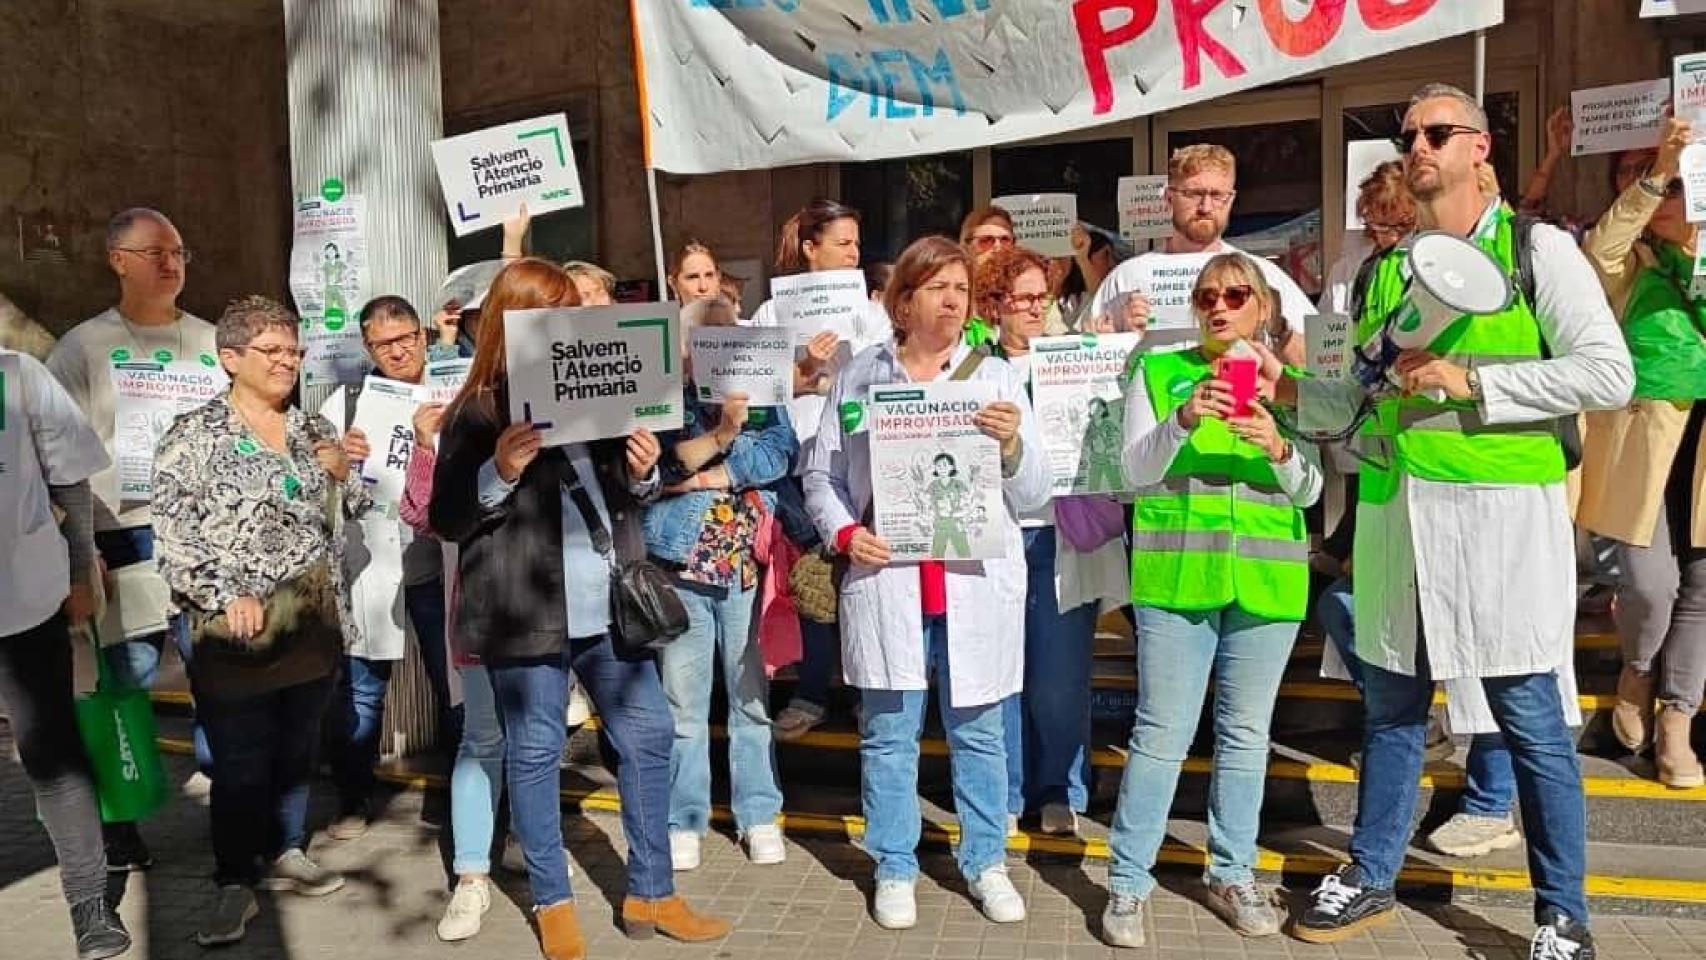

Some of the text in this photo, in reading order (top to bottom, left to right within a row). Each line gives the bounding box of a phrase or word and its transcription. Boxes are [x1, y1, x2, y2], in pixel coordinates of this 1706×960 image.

[471, 148, 529, 171] Salvem
[551, 339, 627, 361] Salvem
[552, 354, 643, 381] l'Atenció
[554, 377, 637, 402] Primària
[876, 413, 975, 431] IMPROVISAD
